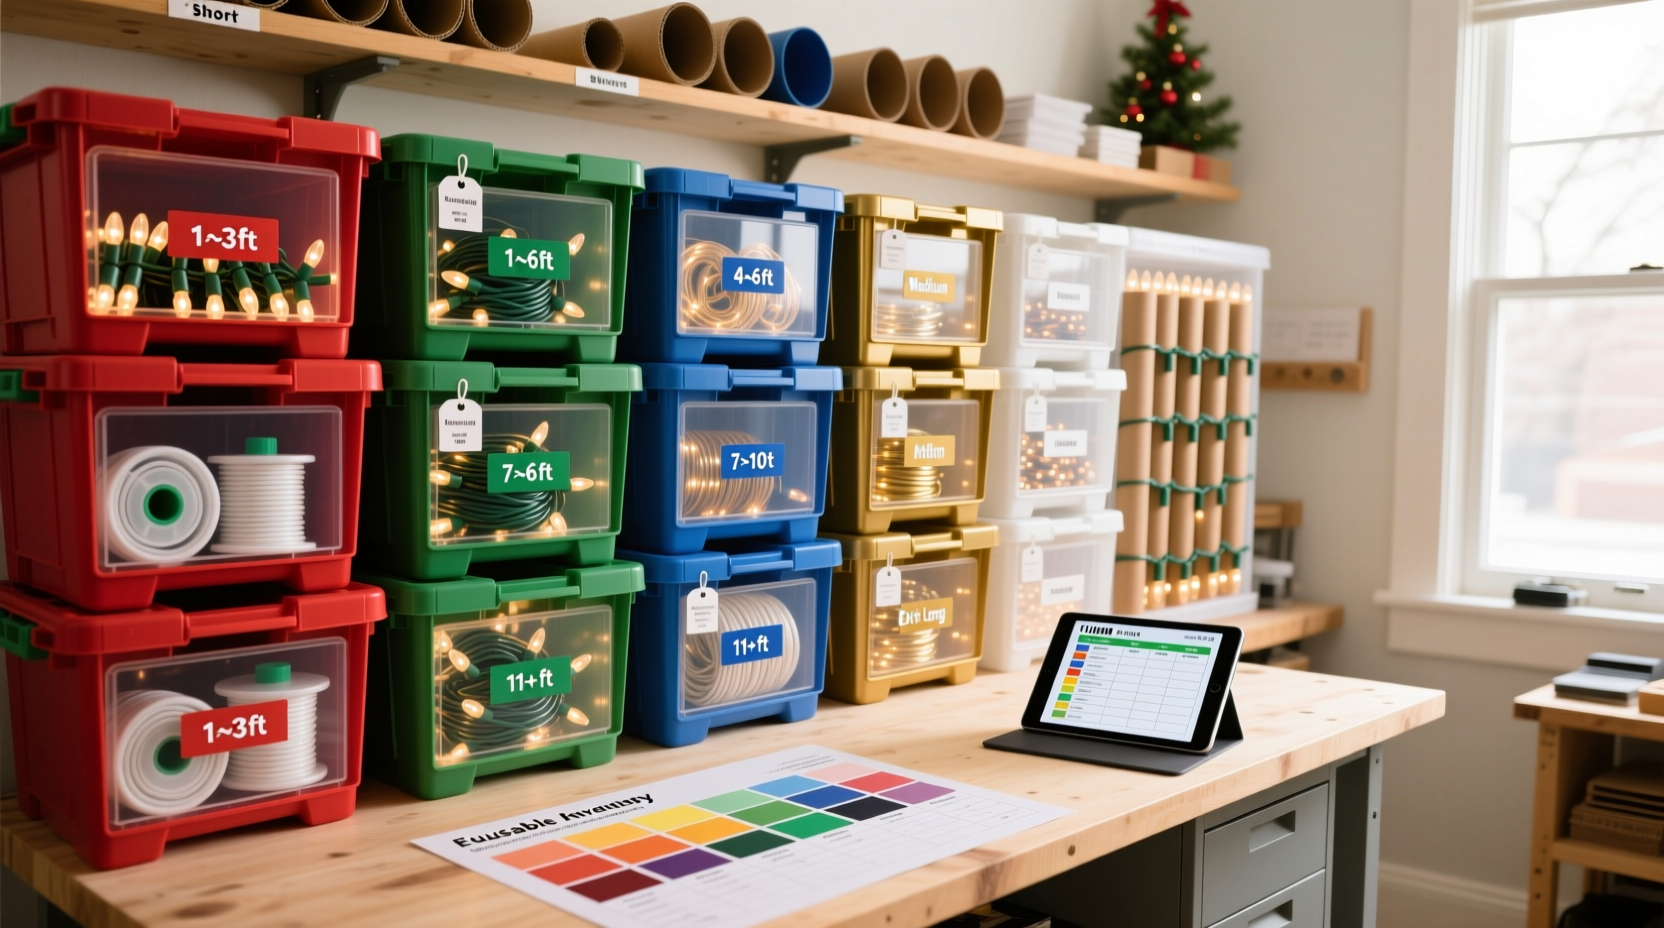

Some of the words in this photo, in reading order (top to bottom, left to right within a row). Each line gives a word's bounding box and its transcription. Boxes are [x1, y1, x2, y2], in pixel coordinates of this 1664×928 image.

[193, 3, 239, 23] Short
[191, 225, 258, 251] 1~3ft
[203, 714, 268, 744] 1~3ft
